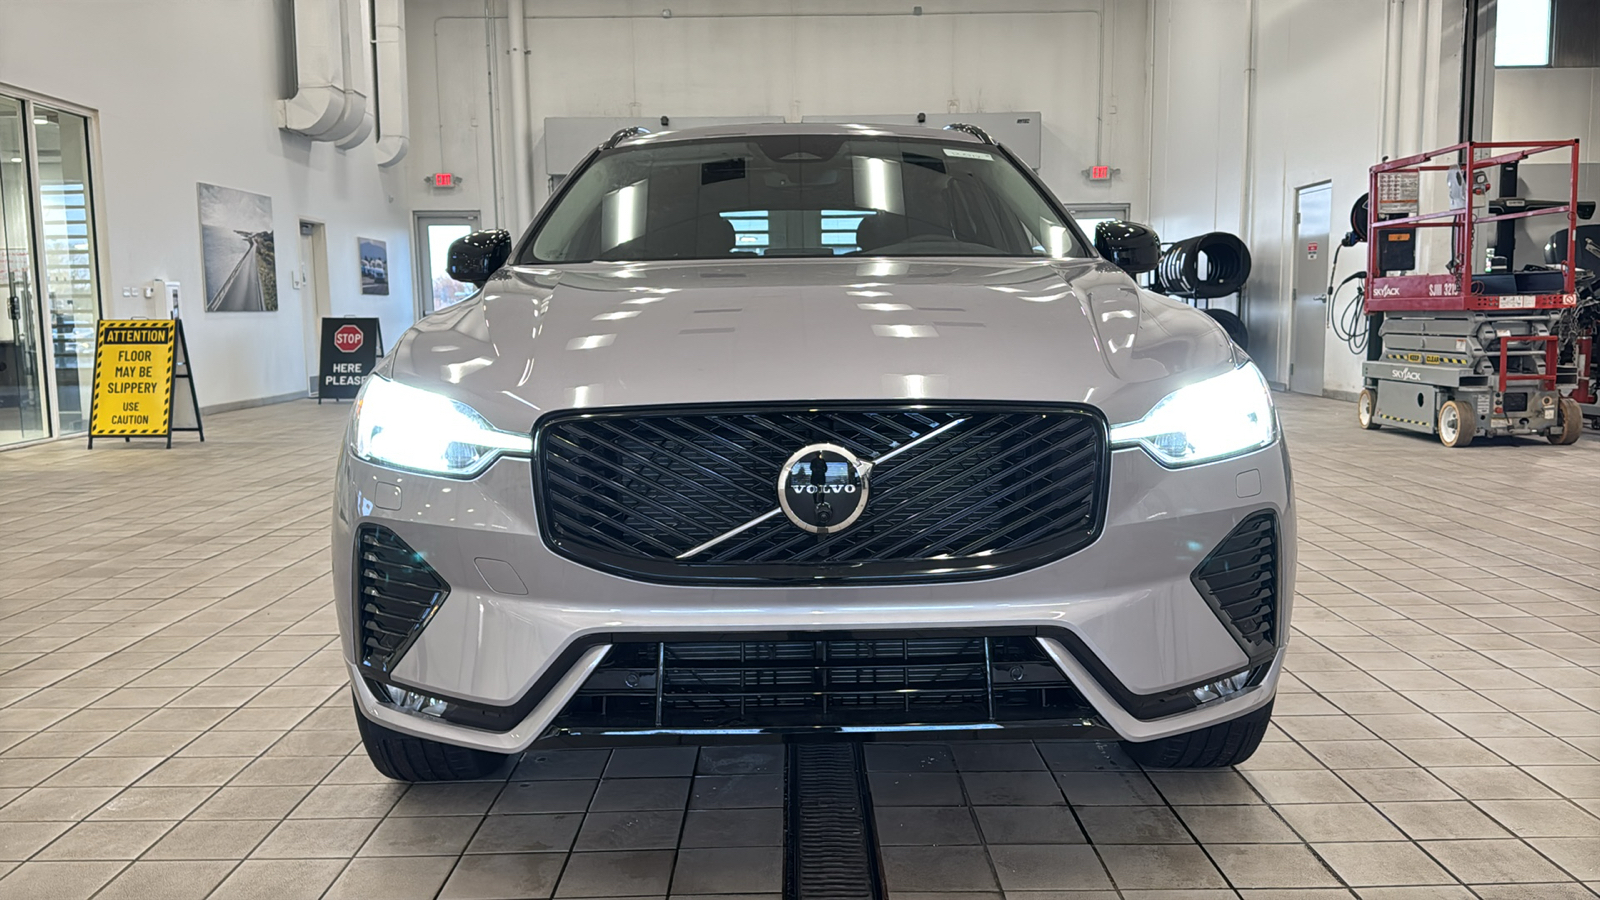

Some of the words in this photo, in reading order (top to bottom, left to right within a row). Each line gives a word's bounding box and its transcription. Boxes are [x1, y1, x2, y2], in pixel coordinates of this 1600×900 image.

[1093, 166, 1108, 178] EXIT
[436, 173, 451, 185] EXIT
[1373, 284, 1400, 297] SKYJACK
[106, 330, 166, 342] ATTENTION
[336, 333, 361, 344] STOP
[118, 350, 152, 361] FLOOR
[115, 366, 136, 377] MAY
[139, 366, 152, 377] BE
[333, 363, 362, 373] HERE
[1392, 367, 1421, 380] SKYJACK
[107, 382, 157, 393] SLIPPERY
[122, 402, 140, 411] USE
[111, 415, 149, 424] CAUTION
[791, 484, 856, 494] VOLVO
